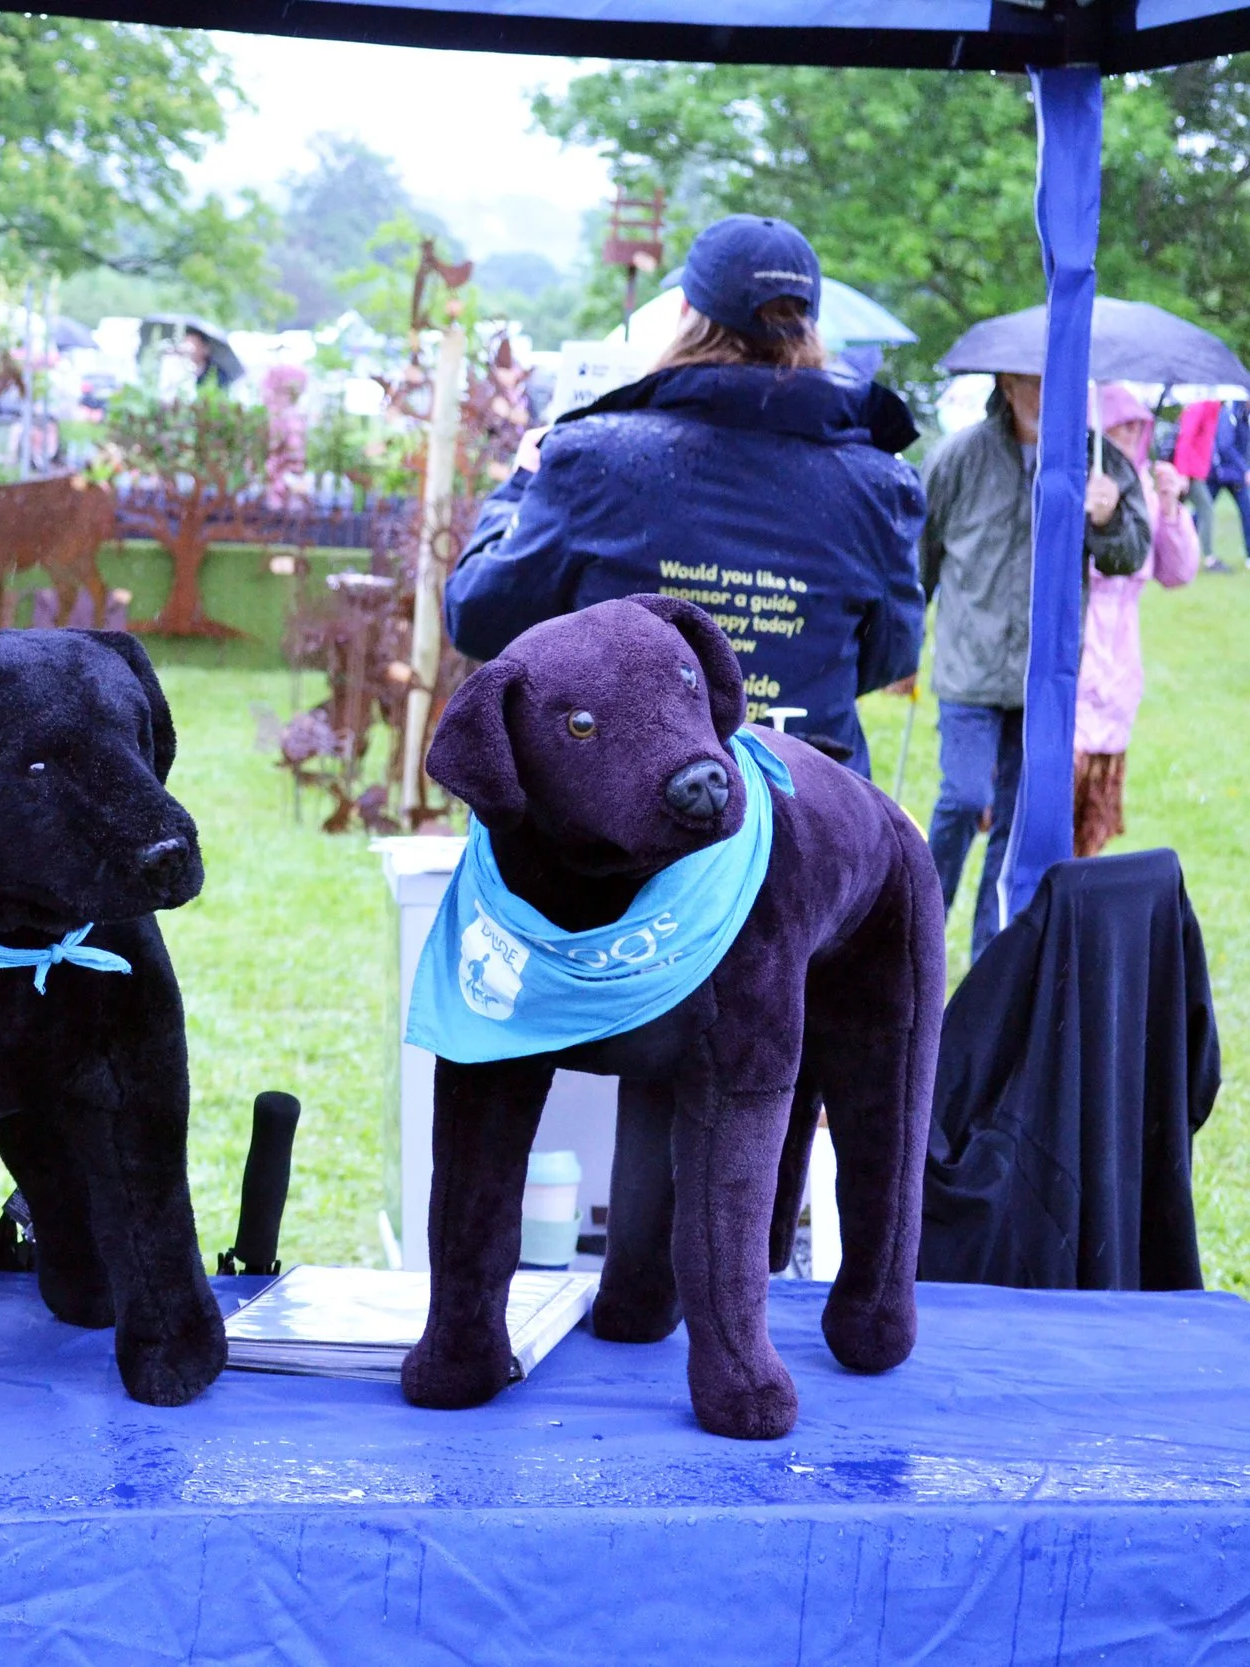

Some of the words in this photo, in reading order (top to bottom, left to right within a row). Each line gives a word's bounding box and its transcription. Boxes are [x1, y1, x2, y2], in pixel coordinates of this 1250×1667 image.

[659, 559, 718, 582] Would
[720, 569, 753, 587] you
[756, 569, 787, 590] like
[788, 576, 808, 593] to
[733, 593, 748, 608] a
[750, 592, 798, 613] guide
[713, 613, 750, 635] ppy
[752, 614, 805, 639] today?
[730, 638, 757, 653] ow
[743, 672, 780, 699] ide
[745, 702, 770, 723] gs
